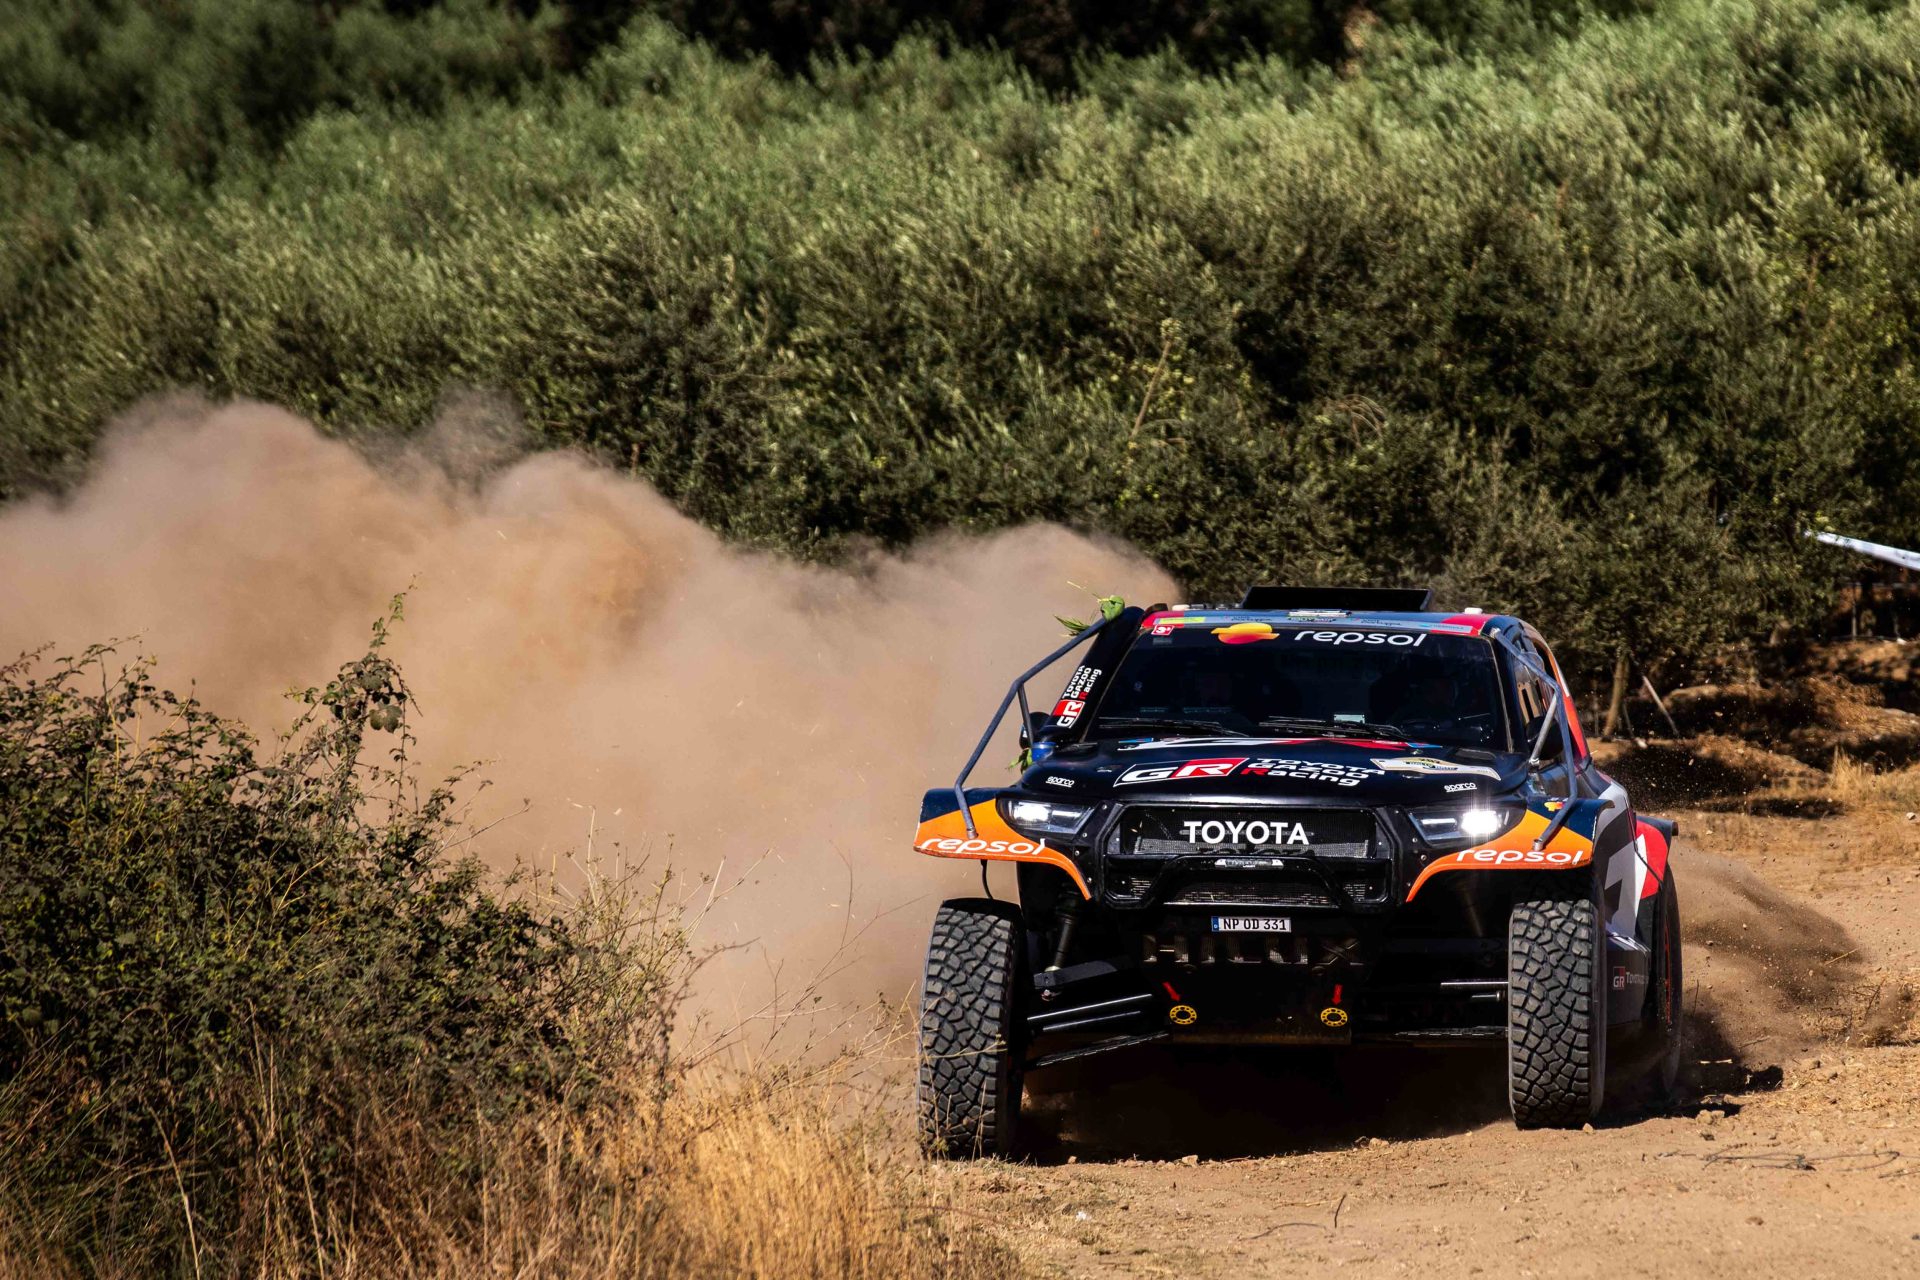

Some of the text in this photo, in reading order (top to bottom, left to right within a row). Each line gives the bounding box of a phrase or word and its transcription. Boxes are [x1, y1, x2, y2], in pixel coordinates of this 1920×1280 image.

[1294, 630, 1427, 647] repsol
[1062, 665, 1085, 699] TOYOTA
[1070, 667, 1092, 699] GAZOO
[1078, 668, 1102, 700] Racing
[1056, 701, 1083, 727] GR
[1121, 762, 1235, 782] GR
[1247, 762, 1369, 779] GAZOO
[1257, 758, 1386, 775] TOYOTA
[1045, 775, 1075, 788] sparco
[1240, 767, 1361, 787] Racing
[1443, 782, 1478, 793] sparco
[1183, 820, 1310, 845] TOYOTA
[919, 838, 1046, 855] repsol
[1456, 849, 1584, 865] repsol
[1223, 918, 1239, 930] NP
[1263, 918, 1287, 931] 331
[1613, 976, 1625, 988] GR
